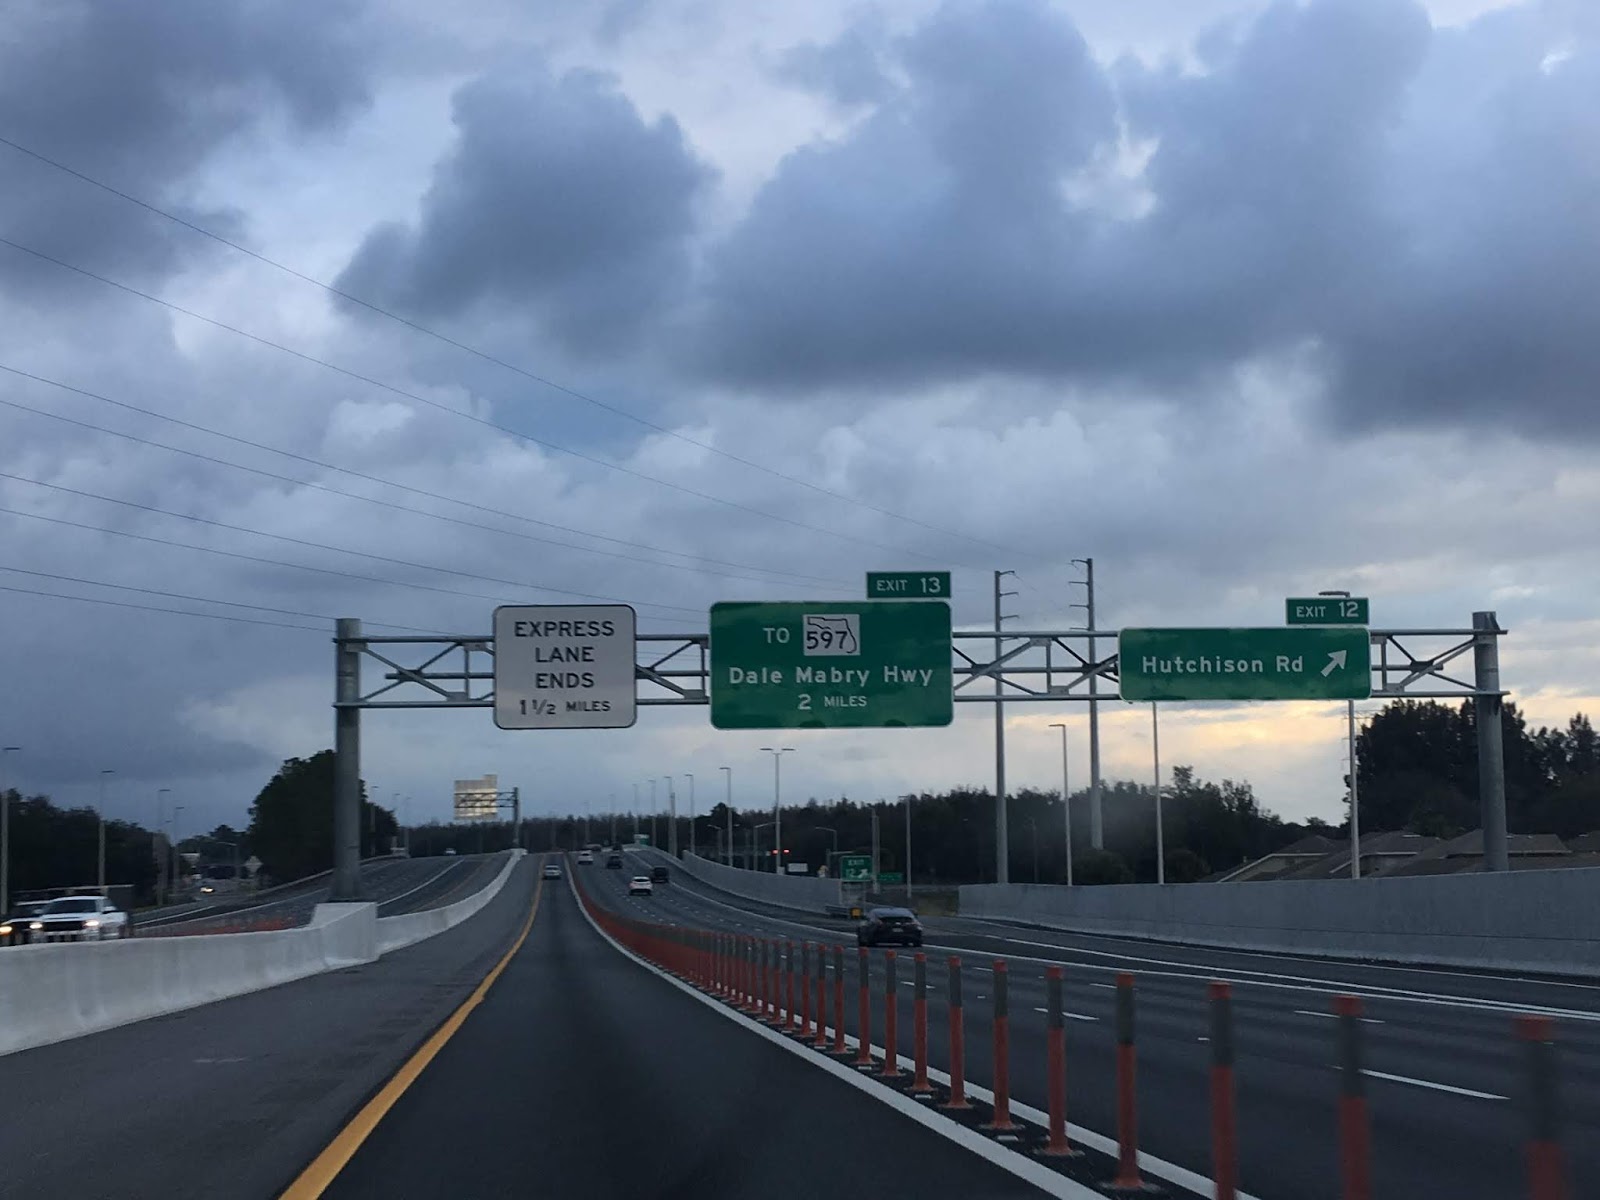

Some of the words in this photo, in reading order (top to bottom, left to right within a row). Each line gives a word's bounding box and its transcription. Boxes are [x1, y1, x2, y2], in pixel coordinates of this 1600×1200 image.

[876, 579, 908, 591] EXIT
[920, 576, 941, 593] 13
[1296, 605, 1326, 617] EXIT
[1339, 601, 1359, 617] 12
[514, 620, 615, 637] EXPRESS
[763, 627, 790, 644] TO
[806, 630, 848, 649] 597
[535, 646, 595, 662] LANE
[1142, 656, 1264, 673] Hutchison
[1276, 655, 1304, 672] Rd
[535, 672, 595, 688] ENDS
[729, 667, 783, 684] Dale
[796, 666, 870, 687] Mabry
[883, 666, 933, 686] Hwy
[565, 700, 611, 712] MILES
[797, 693, 812, 710] 2
[824, 695, 868, 707] MILES
